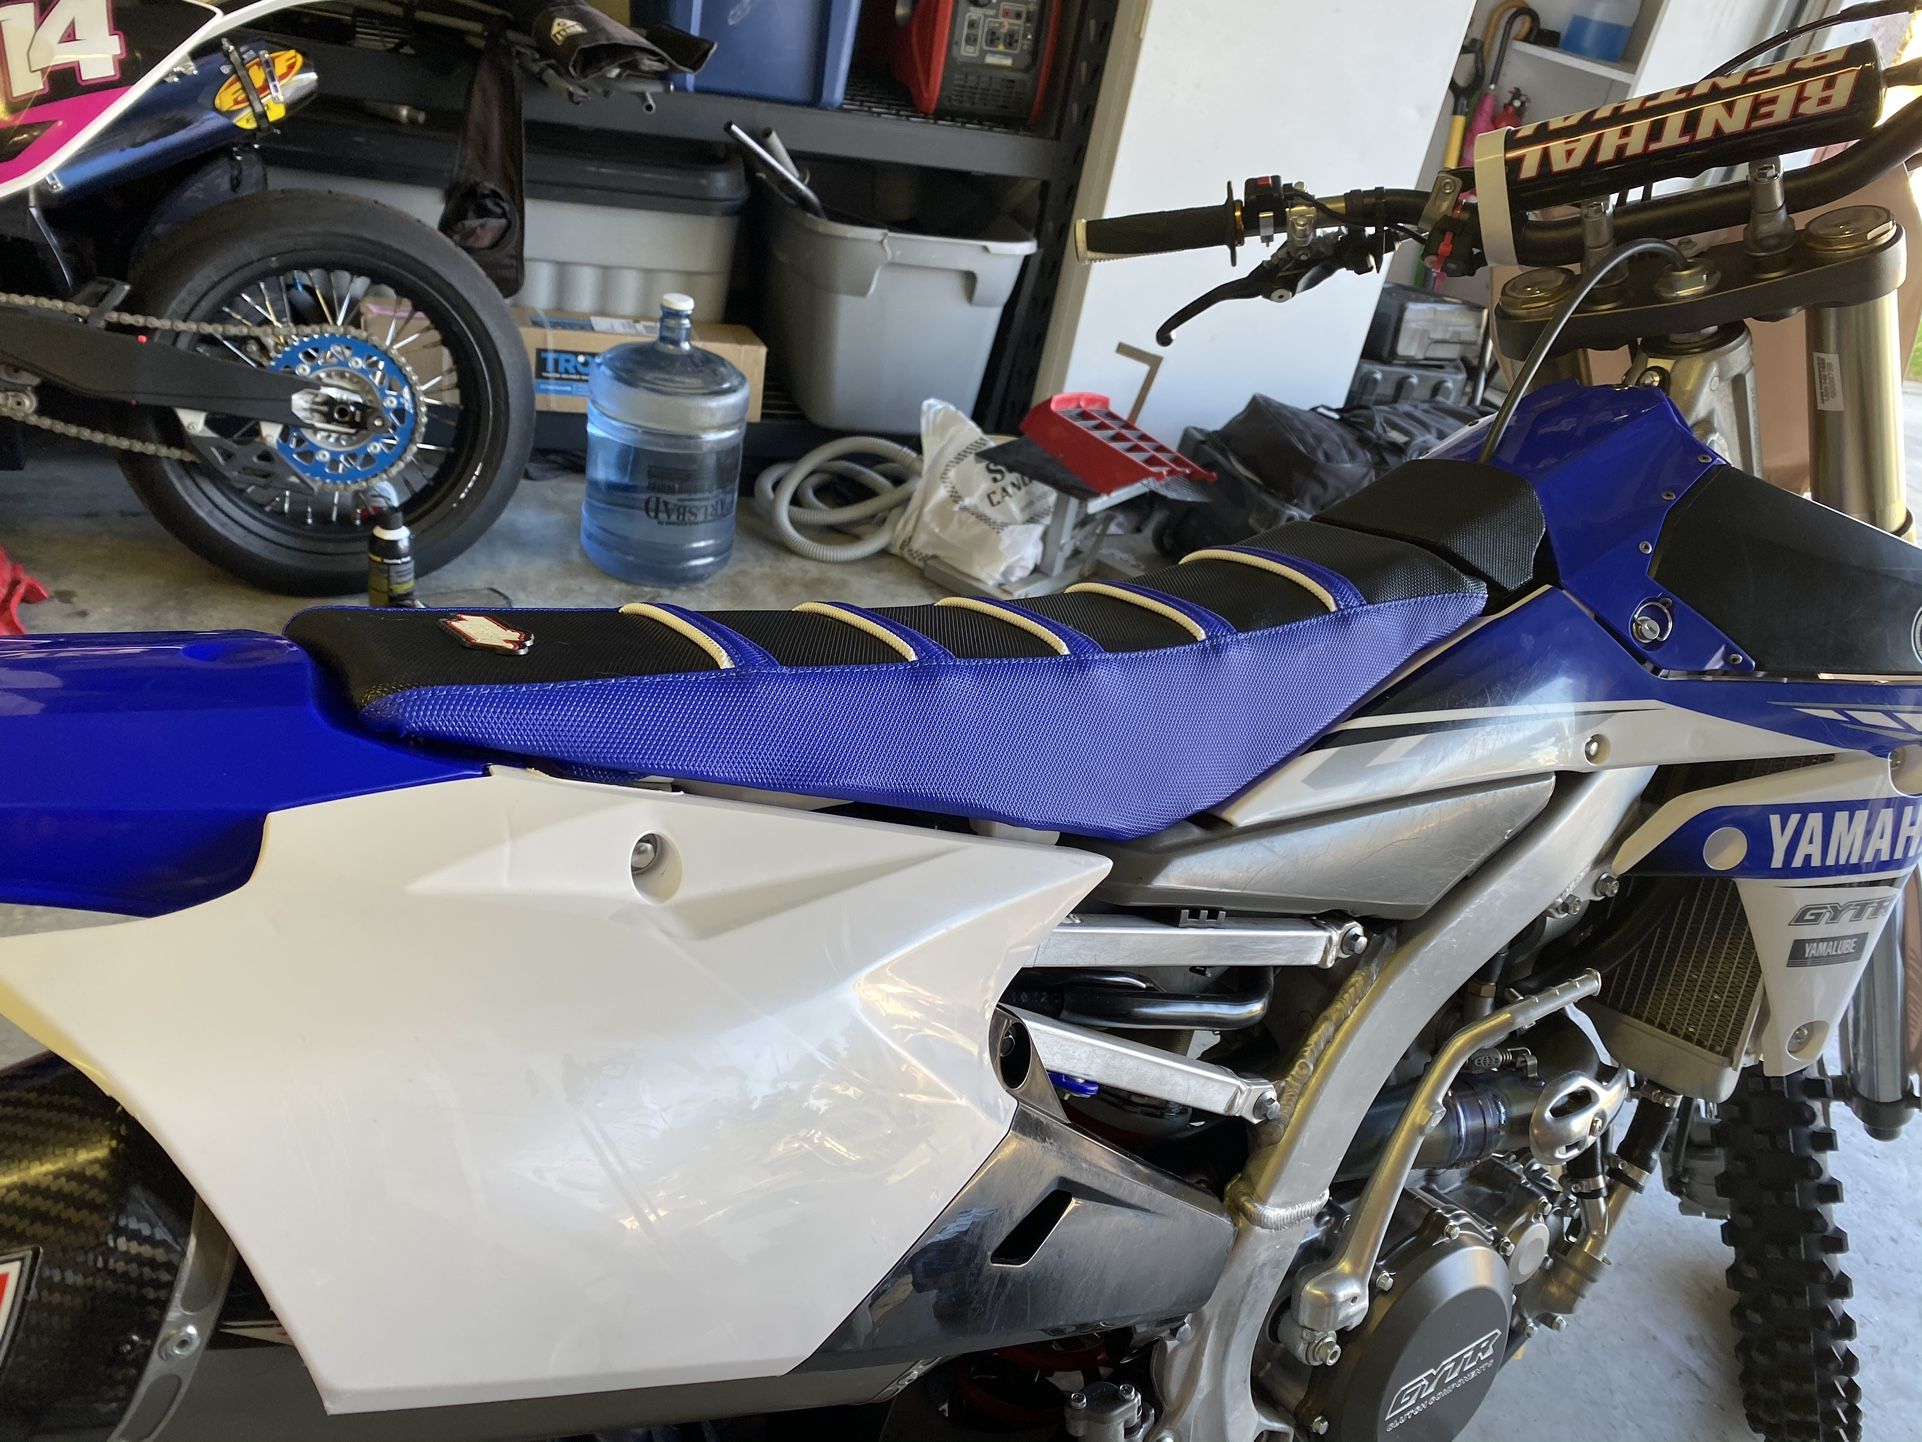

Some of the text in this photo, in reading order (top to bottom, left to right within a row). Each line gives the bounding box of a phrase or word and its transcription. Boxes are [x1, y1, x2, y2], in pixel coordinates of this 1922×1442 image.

[1518, 68, 1859, 180] RENTHAL
[644, 495, 735, 521] ARLSBAD
[1769, 805, 1922, 869] YAMAH
[1804, 938, 1858, 958] YAMALUBE
[1385, 1328, 1502, 1421] GYTR
